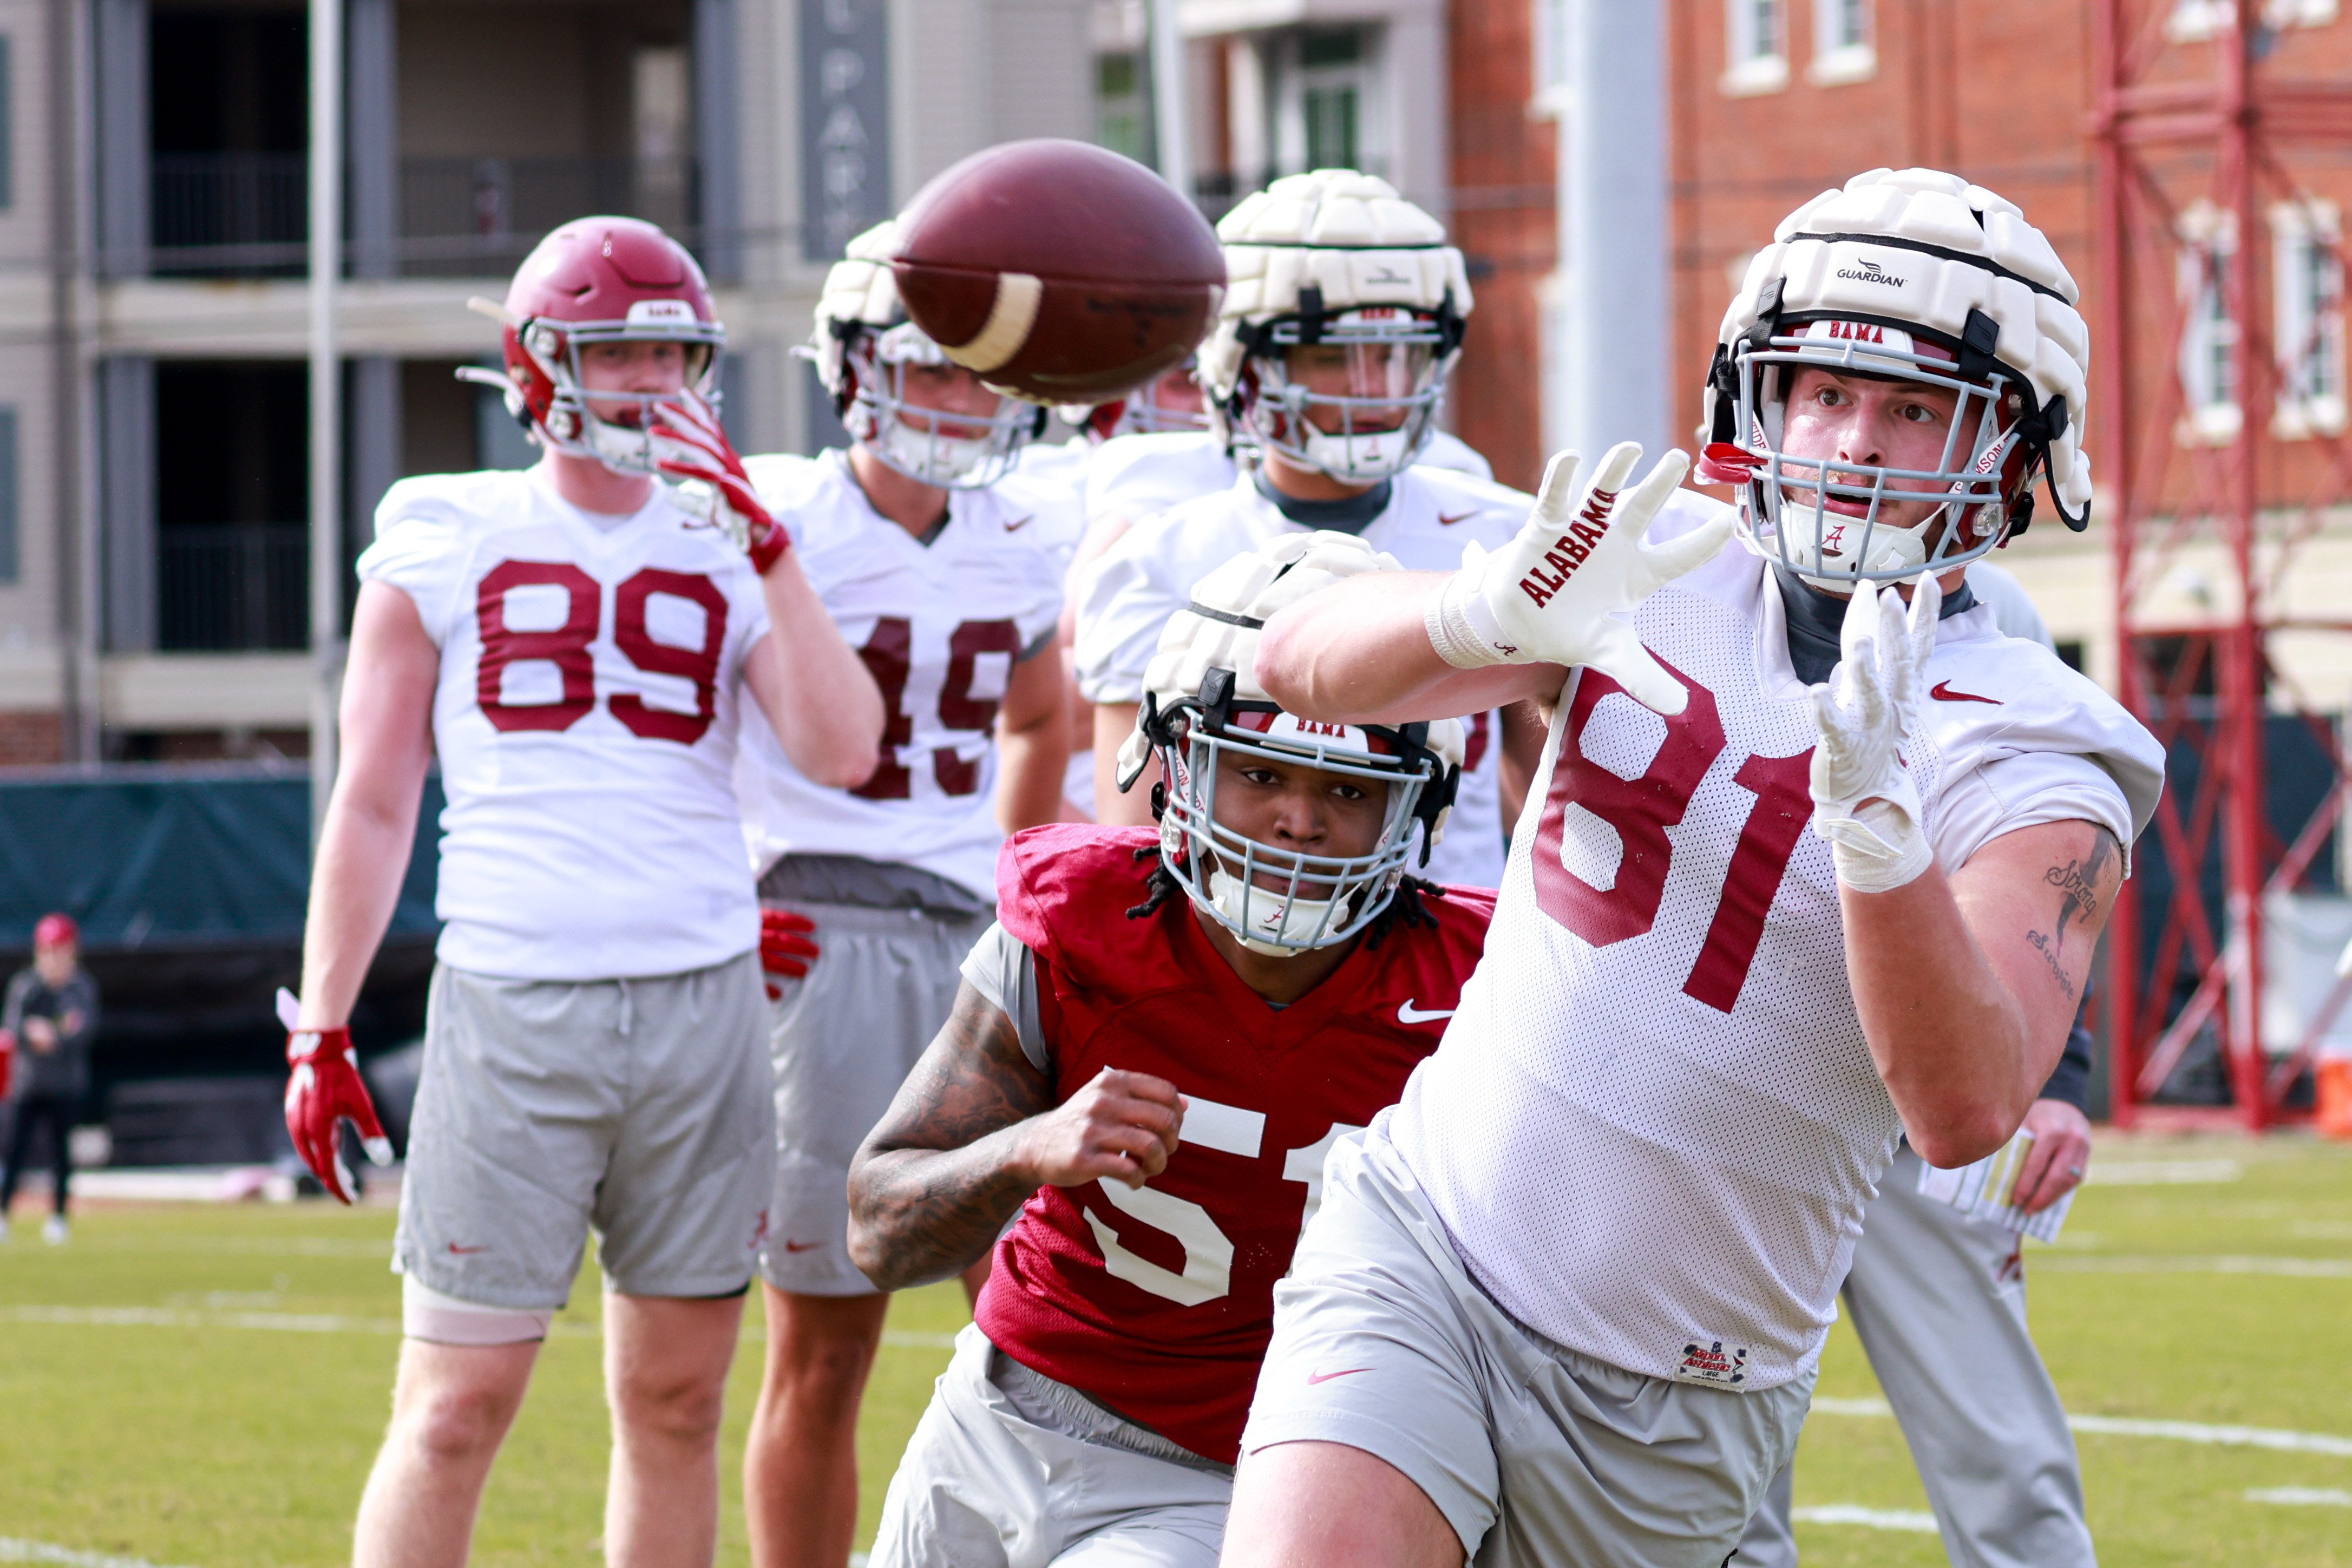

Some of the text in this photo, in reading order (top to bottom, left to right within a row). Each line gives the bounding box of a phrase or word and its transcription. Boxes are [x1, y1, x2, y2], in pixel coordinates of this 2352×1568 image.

[1837, 269, 1904, 287] GUARDIAN
[1829, 320, 1883, 344] BAMA
[1519, 487, 1621, 609] ALABAMA
[475, 559, 729, 747] 89
[1296, 718, 1346, 738] BAMA
[1530, 641, 1817, 1015] 81
[2042, 859, 2097, 923] Strong
[1083, 1065, 1367, 1307] 5
[1682, 1356, 1731, 1372] Athletic
